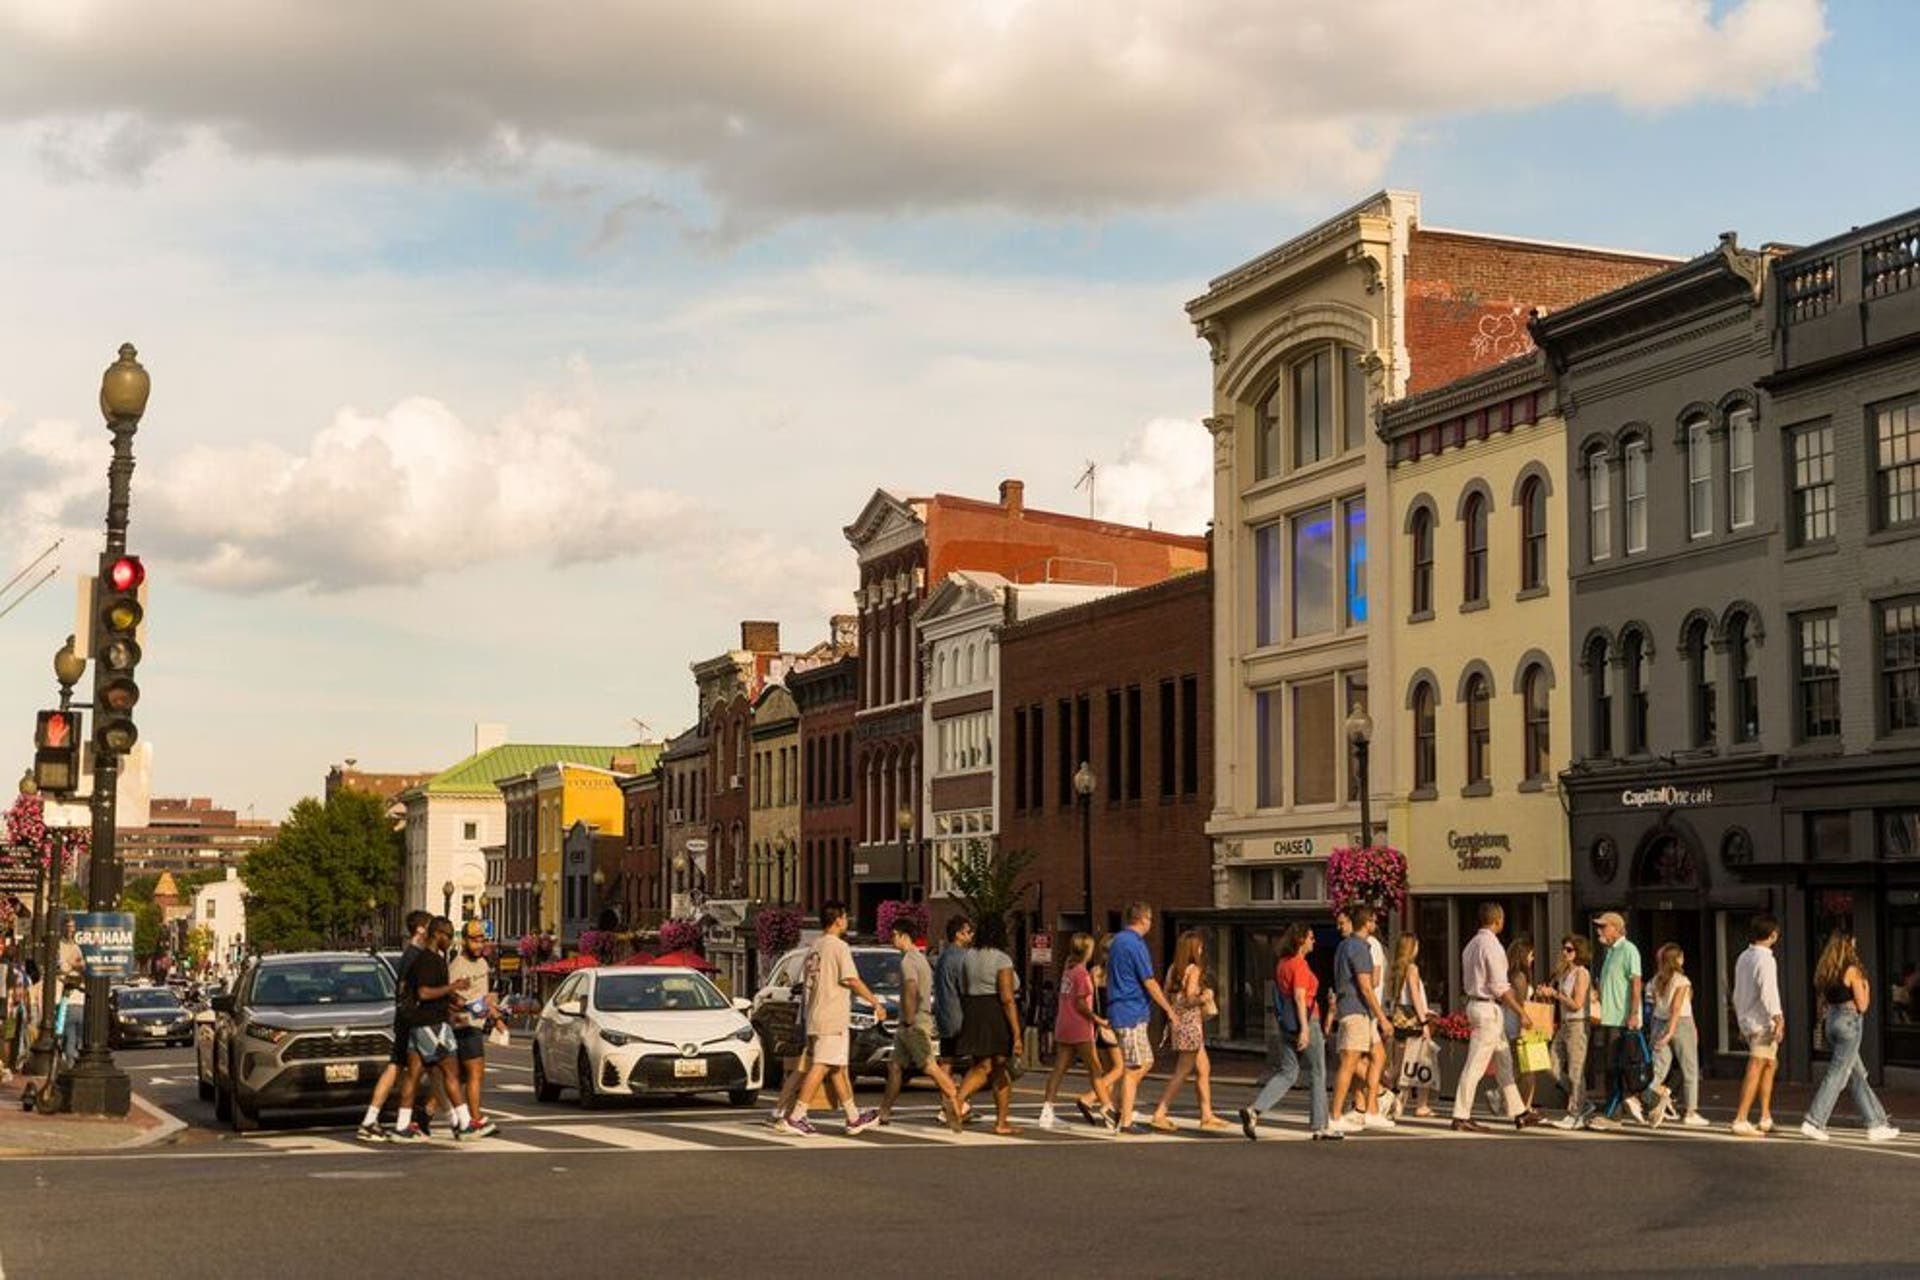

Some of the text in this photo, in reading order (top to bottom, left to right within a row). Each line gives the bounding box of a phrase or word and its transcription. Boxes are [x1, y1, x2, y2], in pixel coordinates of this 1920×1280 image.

[1273, 840, 1304, 856] CHASE
[75, 931, 133, 945] GRAHAM
[1404, 1062, 1432, 1083] UO
